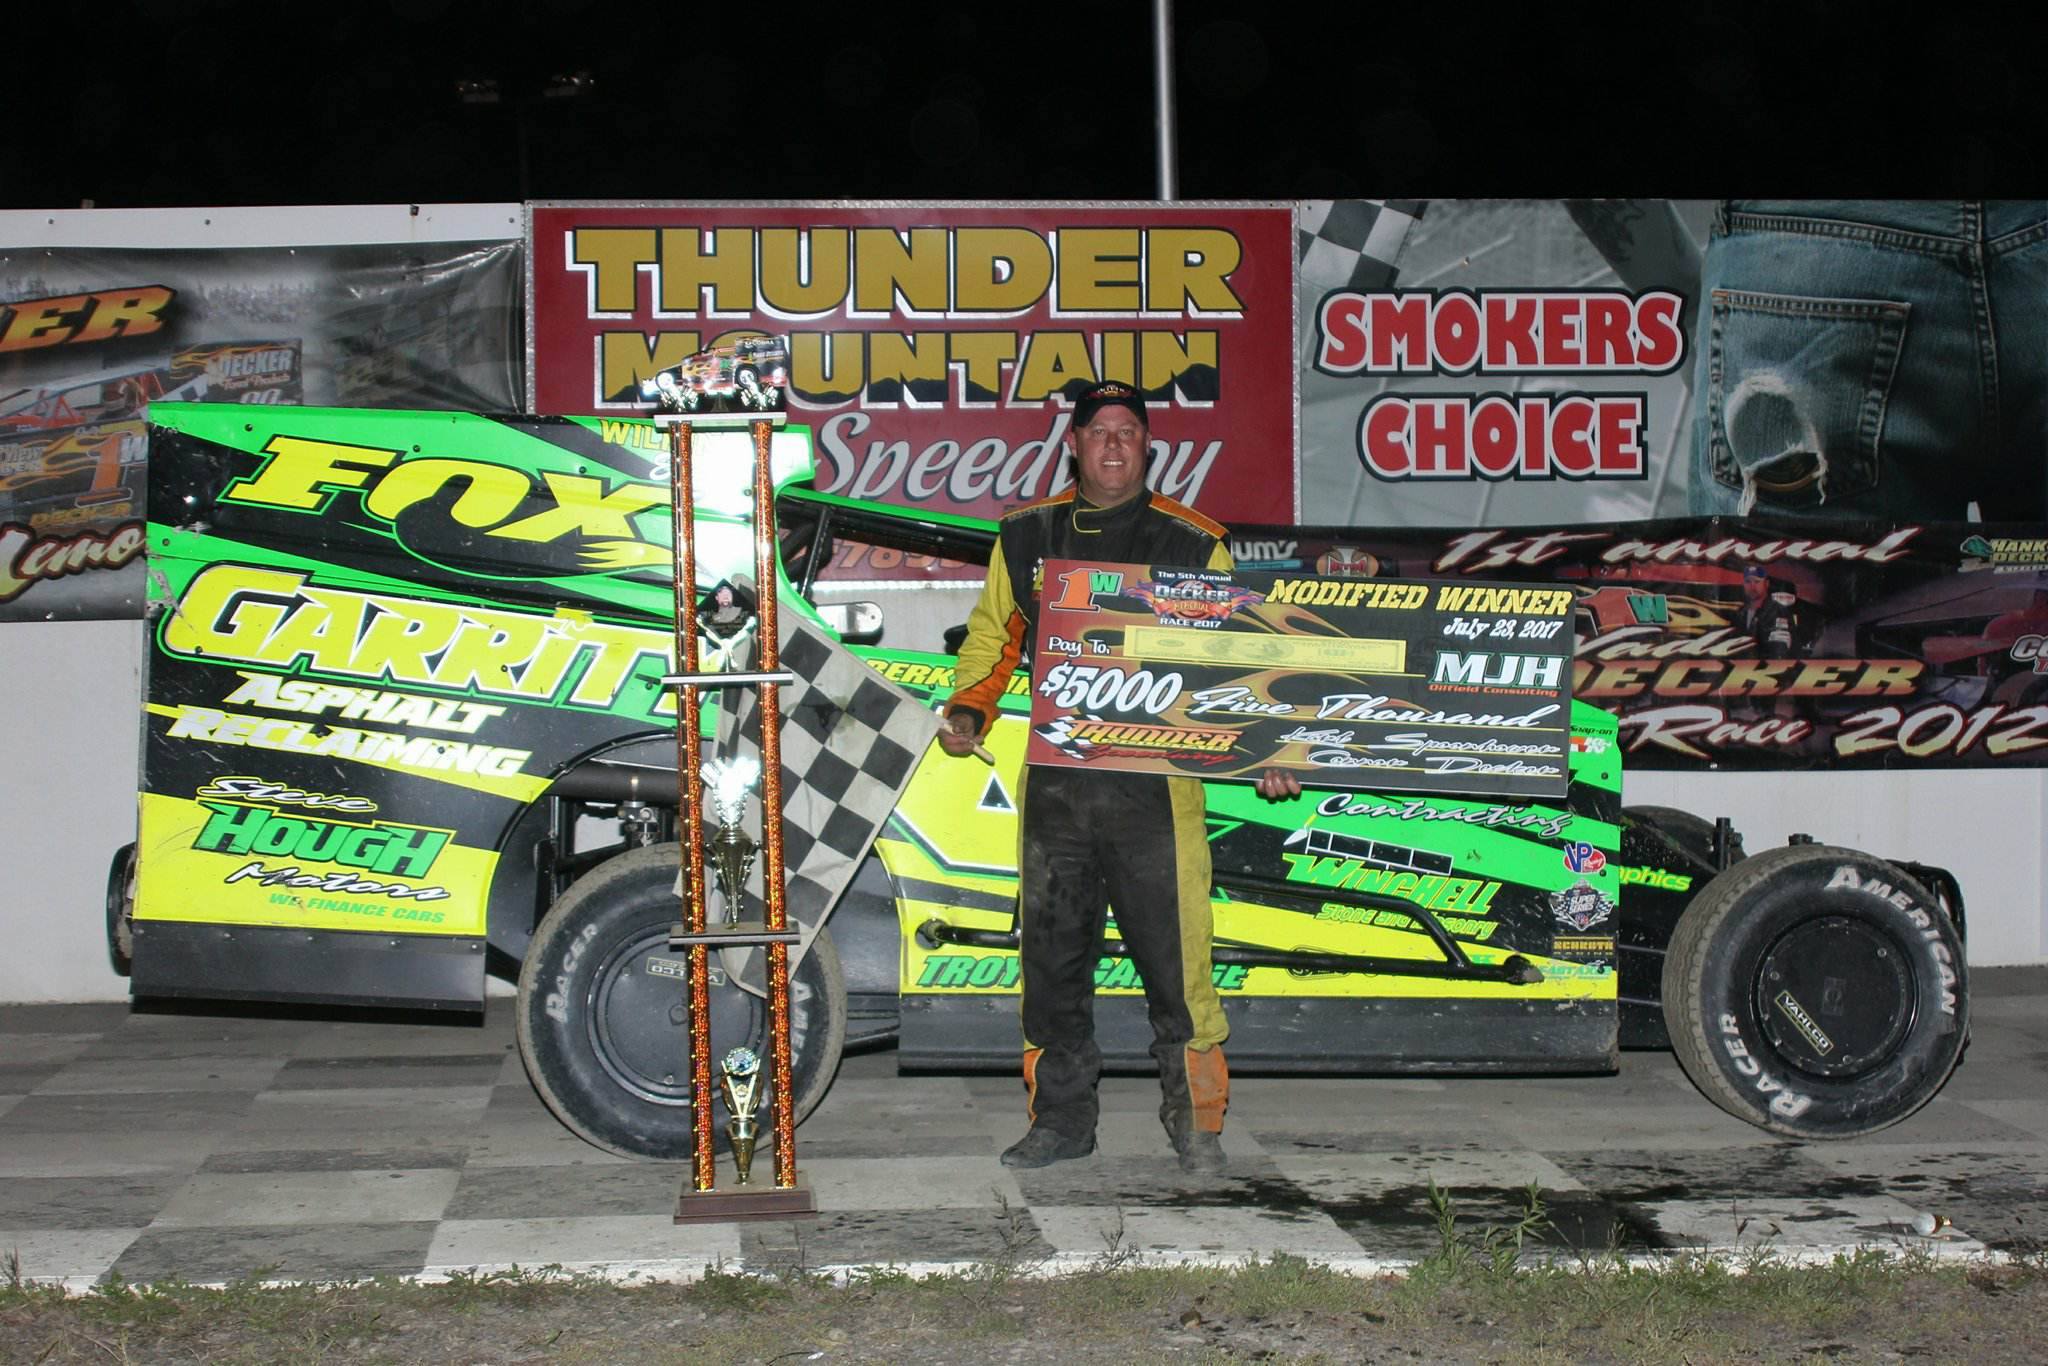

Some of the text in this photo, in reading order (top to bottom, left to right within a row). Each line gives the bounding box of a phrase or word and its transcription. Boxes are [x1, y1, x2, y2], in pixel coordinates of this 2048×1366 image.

[566, 226, 1245, 319] THUNDER
[0, 285, 176, 352] ER
[1318, 289, 1685, 375] SMOKERS
[1360, 394, 1645, 478] CHOICE
[812, 412, 1223, 508] Speedy
[226, 436, 670, 541] FOX
[1232, 539, 1299, 561] um's
[1432, 527, 1924, 574] 1st annual
[1992, 539, 2048, 553] HANK
[1992, 552, 2048, 563] DECK
[1154, 584, 1232, 601] DECKER
[1157, 570, 1176, 579] The
[1178, 572, 1197, 581] 5th
[1199, 573, 1232, 583] Annual
[1265, 578, 1573, 616] MODIFIED WINNER
[1159, 616, 1222, 629] RACE 2017
[1443, 617, 1490, 640] July
[1518, 621, 1564, 639] 2017
[1048, 636, 1083, 658] Pay
[1430, 650, 1568, 686] MJH
[223, 671, 507, 734] ASPHALT
[1191, 686, 1561, 729] Five Thousand
[1429, 684, 1558, 698] Oilfield Consulting
[166, 704, 532, 778] RECLAIMING
[1066, 719, 1243, 752] THUNDER
[1620, 703, 2048, 760] Race 2012
[198, 777, 377, 812] Steve
[1316, 793, 1574, 837] Contracting
[191, 800, 452, 878] HOUGH
[224, 861, 451, 901] Motors
[1282, 852, 1503, 915] WINCHELL
[1619, 865, 1693, 892] phics
[269, 893, 446, 924] WE FINANCE CARS
[1315, 903, 1378, 924] Stone
[1409, 911, 1500, 941] sonry
[1824, 865, 1956, 1015] AMERICAN
[545, 922, 598, 1024] RACER
[646, 964, 720, 982] VLCO
[914, 955, 1020, 989] TROY
[1783, 995, 1829, 1050] VAHLCO
[1719, 1012, 1812, 1118] RACER
